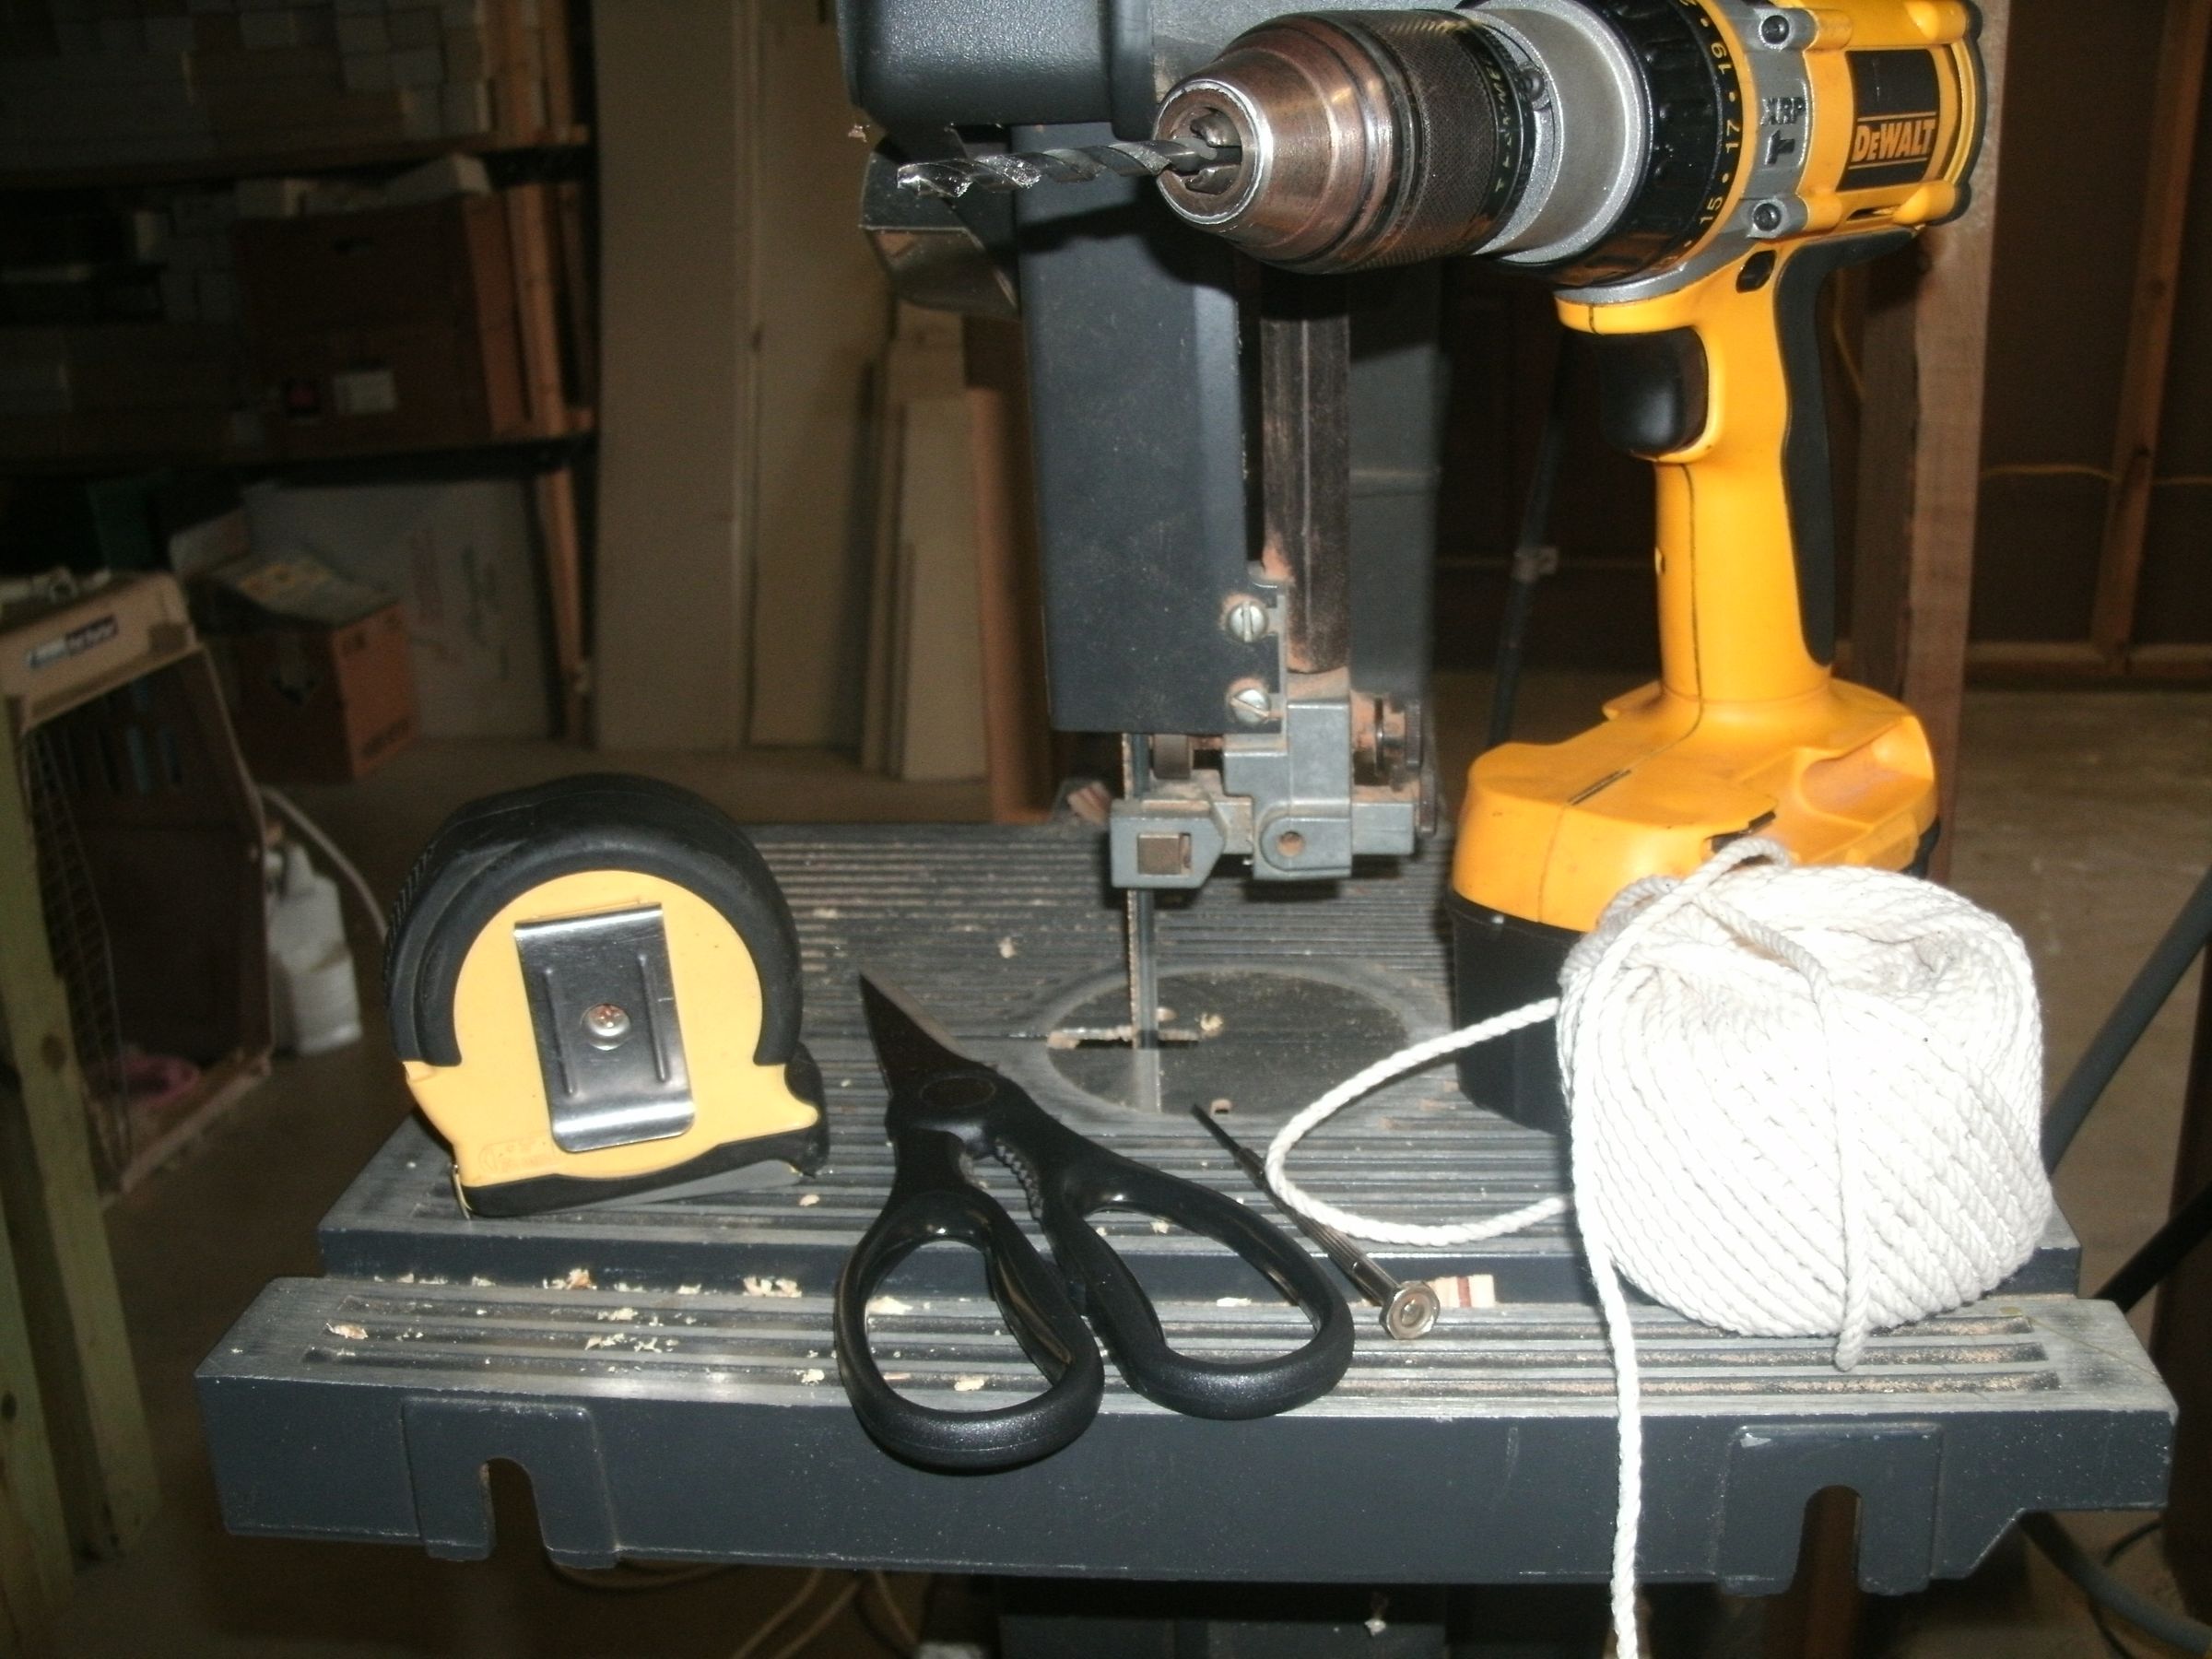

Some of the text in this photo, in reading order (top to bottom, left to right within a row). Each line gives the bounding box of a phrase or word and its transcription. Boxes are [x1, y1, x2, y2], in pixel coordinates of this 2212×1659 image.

[1711, 42, 1732, 75] 19
[1725, 119, 1740, 153] 17
[1700, 195, 1724, 225] 15
